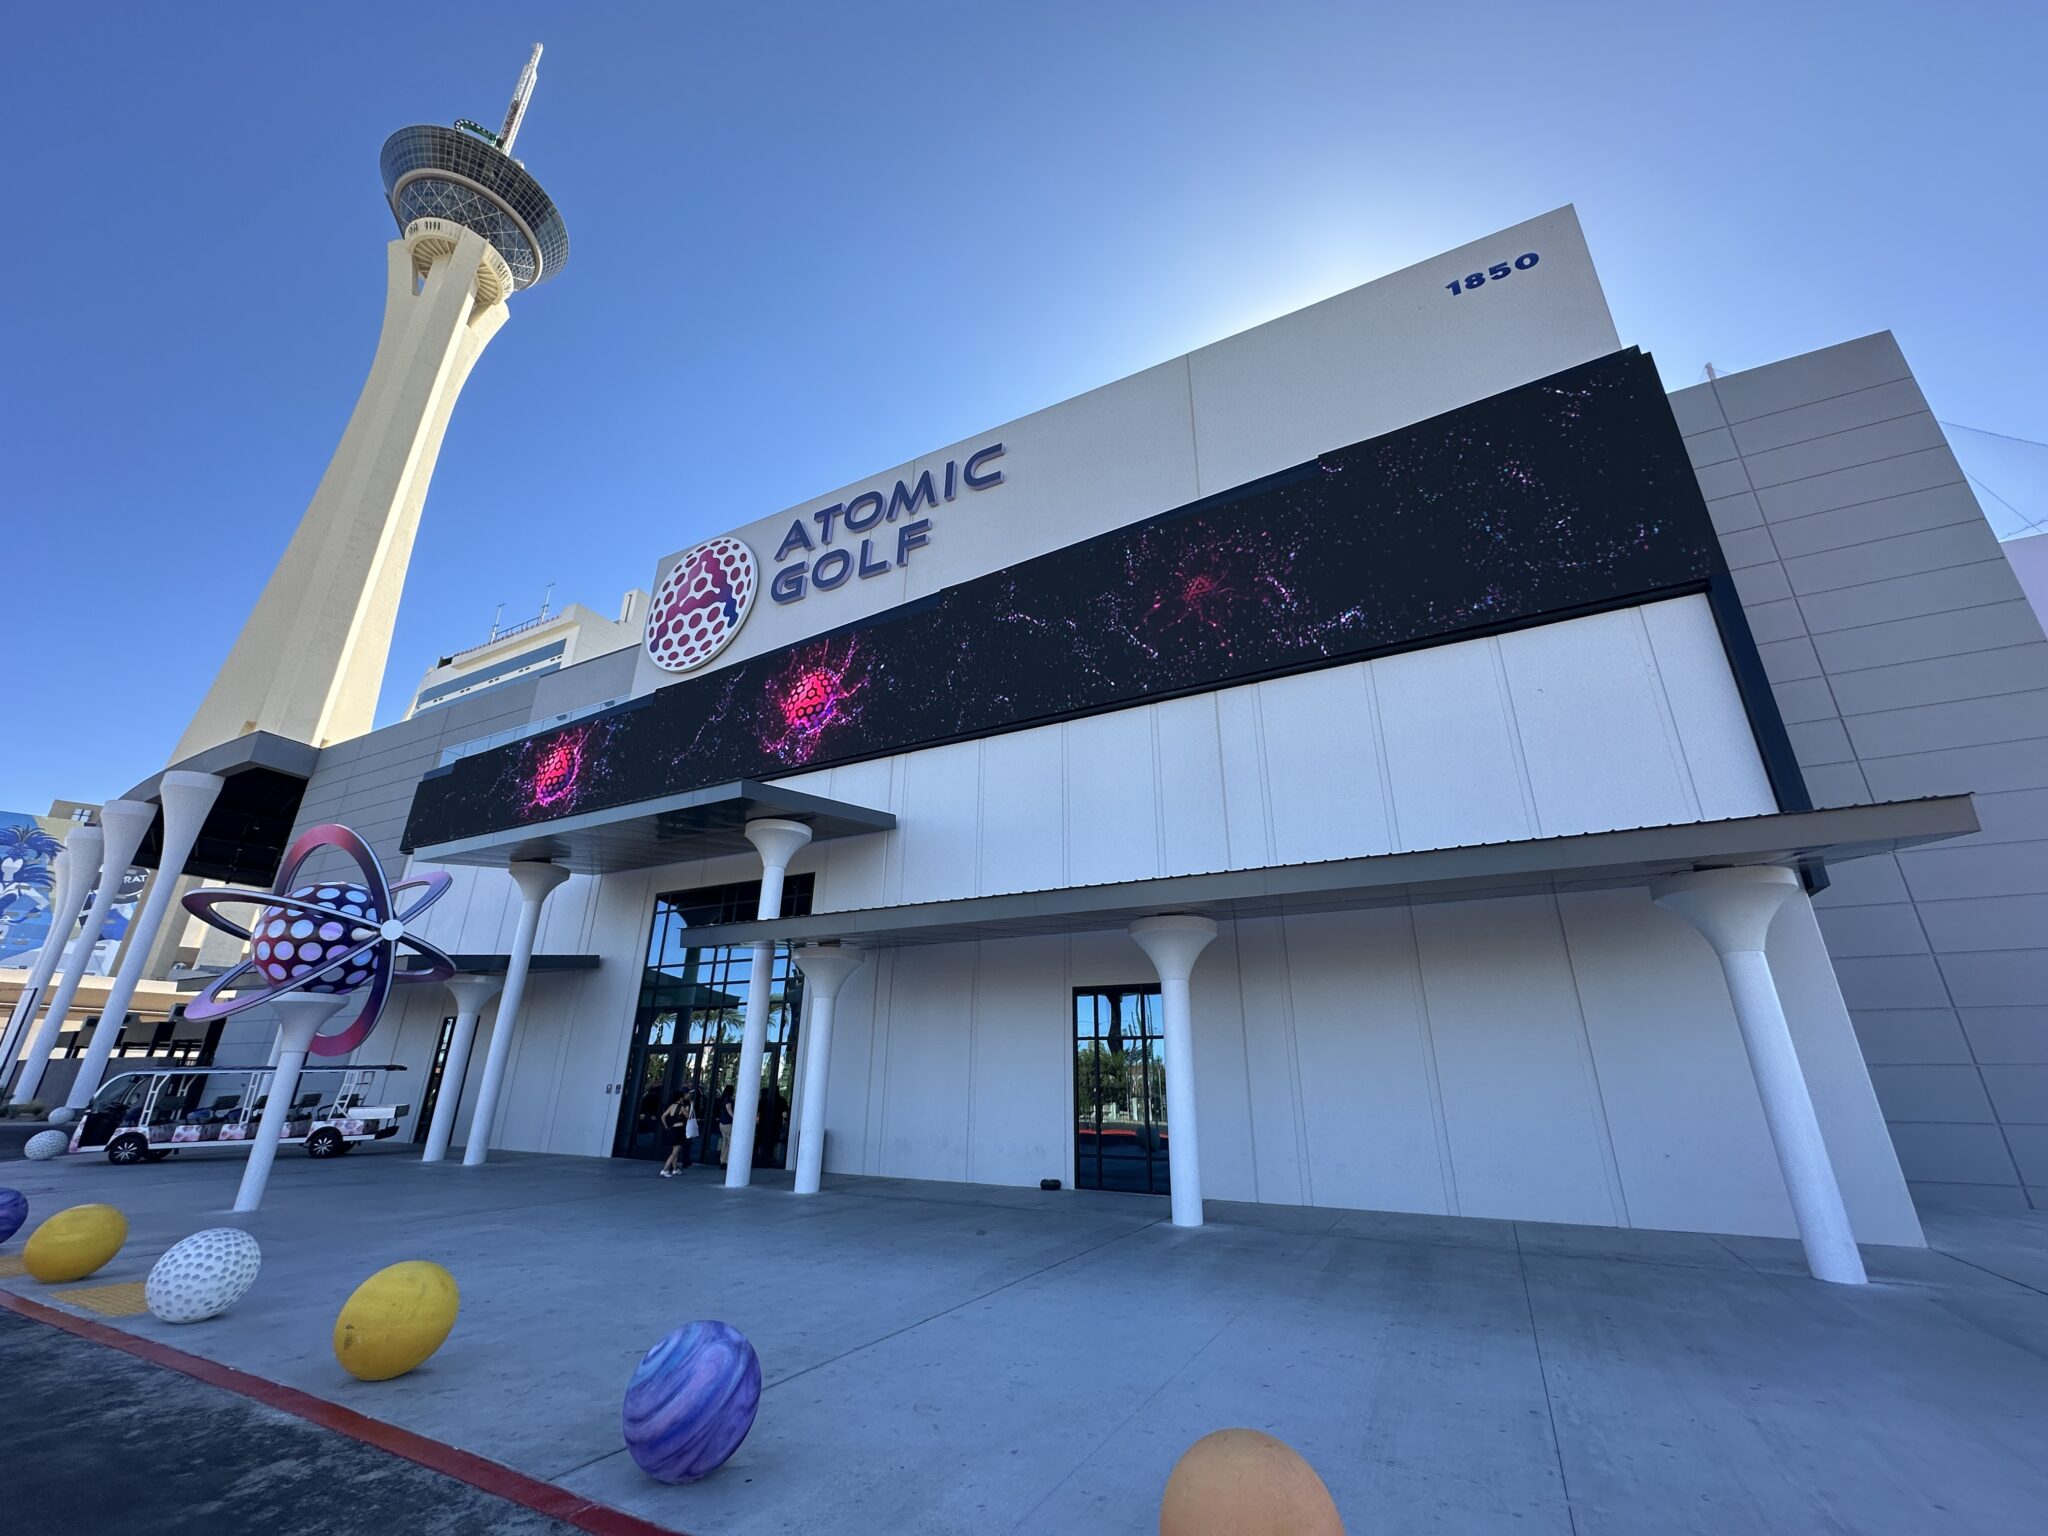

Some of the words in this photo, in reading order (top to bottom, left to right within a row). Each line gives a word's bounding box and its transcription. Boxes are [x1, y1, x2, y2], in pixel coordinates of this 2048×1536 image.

[1445, 252, 1540, 296] 1850
[774, 443, 1006, 562] ATOMIC
[770, 518, 933, 605] GOLF
